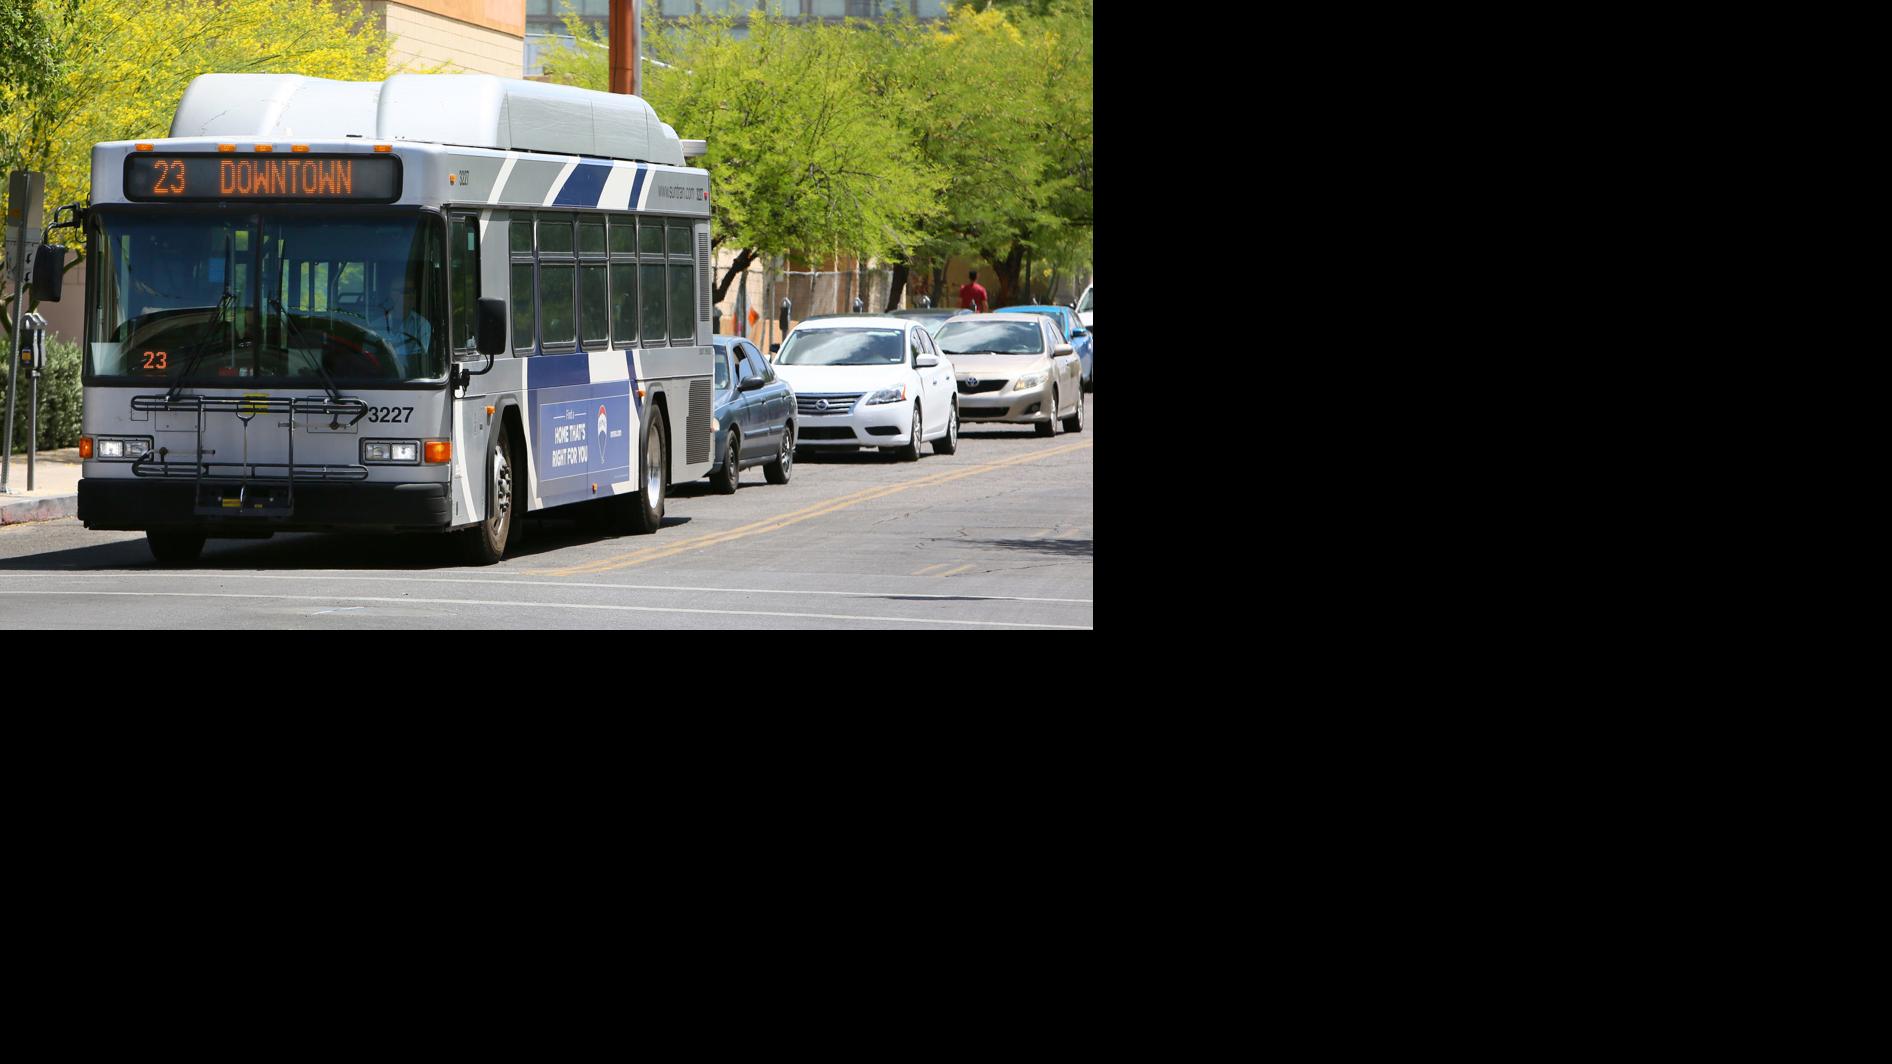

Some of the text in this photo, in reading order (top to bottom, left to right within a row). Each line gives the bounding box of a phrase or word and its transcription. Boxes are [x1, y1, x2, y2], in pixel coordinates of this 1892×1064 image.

[153, 159, 352, 194] 23 DOWNTOWN
[143, 351, 167, 369] 23
[368, 406, 414, 423] 3227
[554, 423, 586, 444] HOME THAT'S
[552, 445, 588, 467] RIGHT FOR YOU
